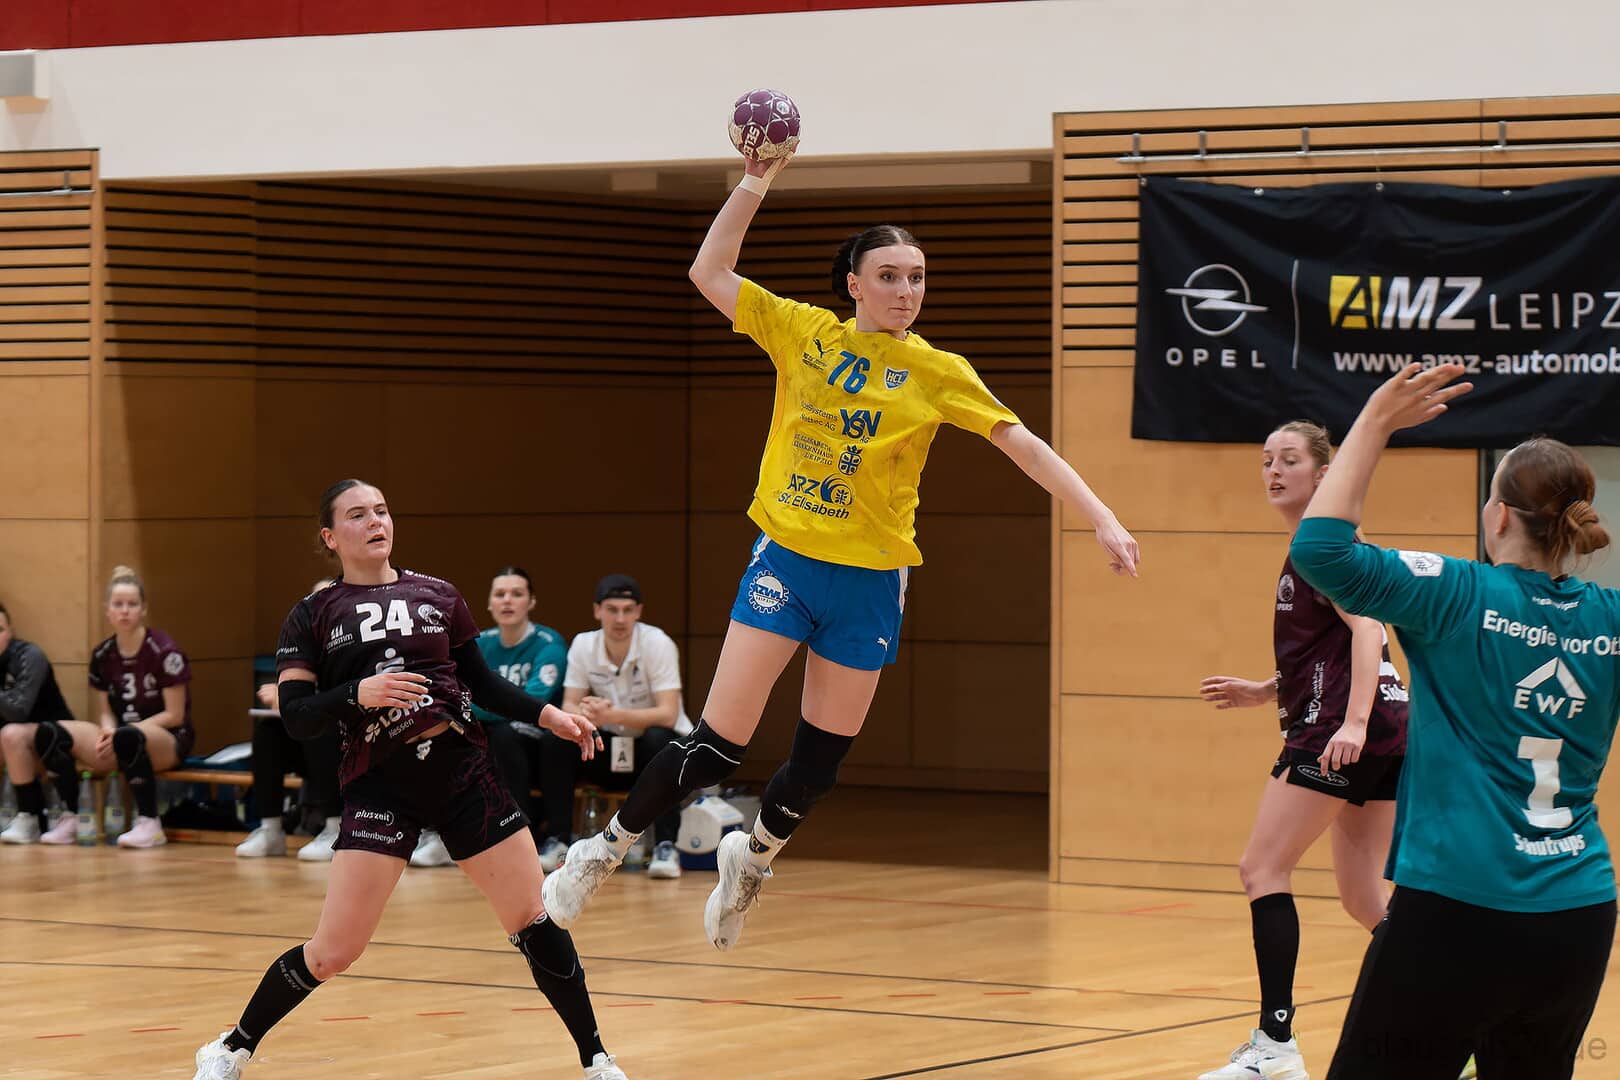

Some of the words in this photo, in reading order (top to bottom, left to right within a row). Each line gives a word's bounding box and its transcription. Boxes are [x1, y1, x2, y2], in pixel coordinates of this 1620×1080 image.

[1329, 275, 1483, 330] AMZ
[1489, 290, 1620, 331] LEIPZ
[1165, 347, 1266, 368] OPEL
[1333, 346, 1620, 375] wwwamz-automob
[828, 350, 870, 394] 76
[787, 473, 820, 497] ARZ
[791, 495, 850, 519] Elisabeth
[356, 600, 414, 643] 24
[1482, 608, 1558, 648] Energie
[1560, 637, 1593, 655] vor
[122, 673, 137, 699] 3
[1513, 688, 1586, 720] EWF
[617, 750, 627, 762] A
[1517, 735, 1573, 829] 1
[355, 809, 391, 823] pluszeit
[352, 830, 397, 844] Hallenberger
